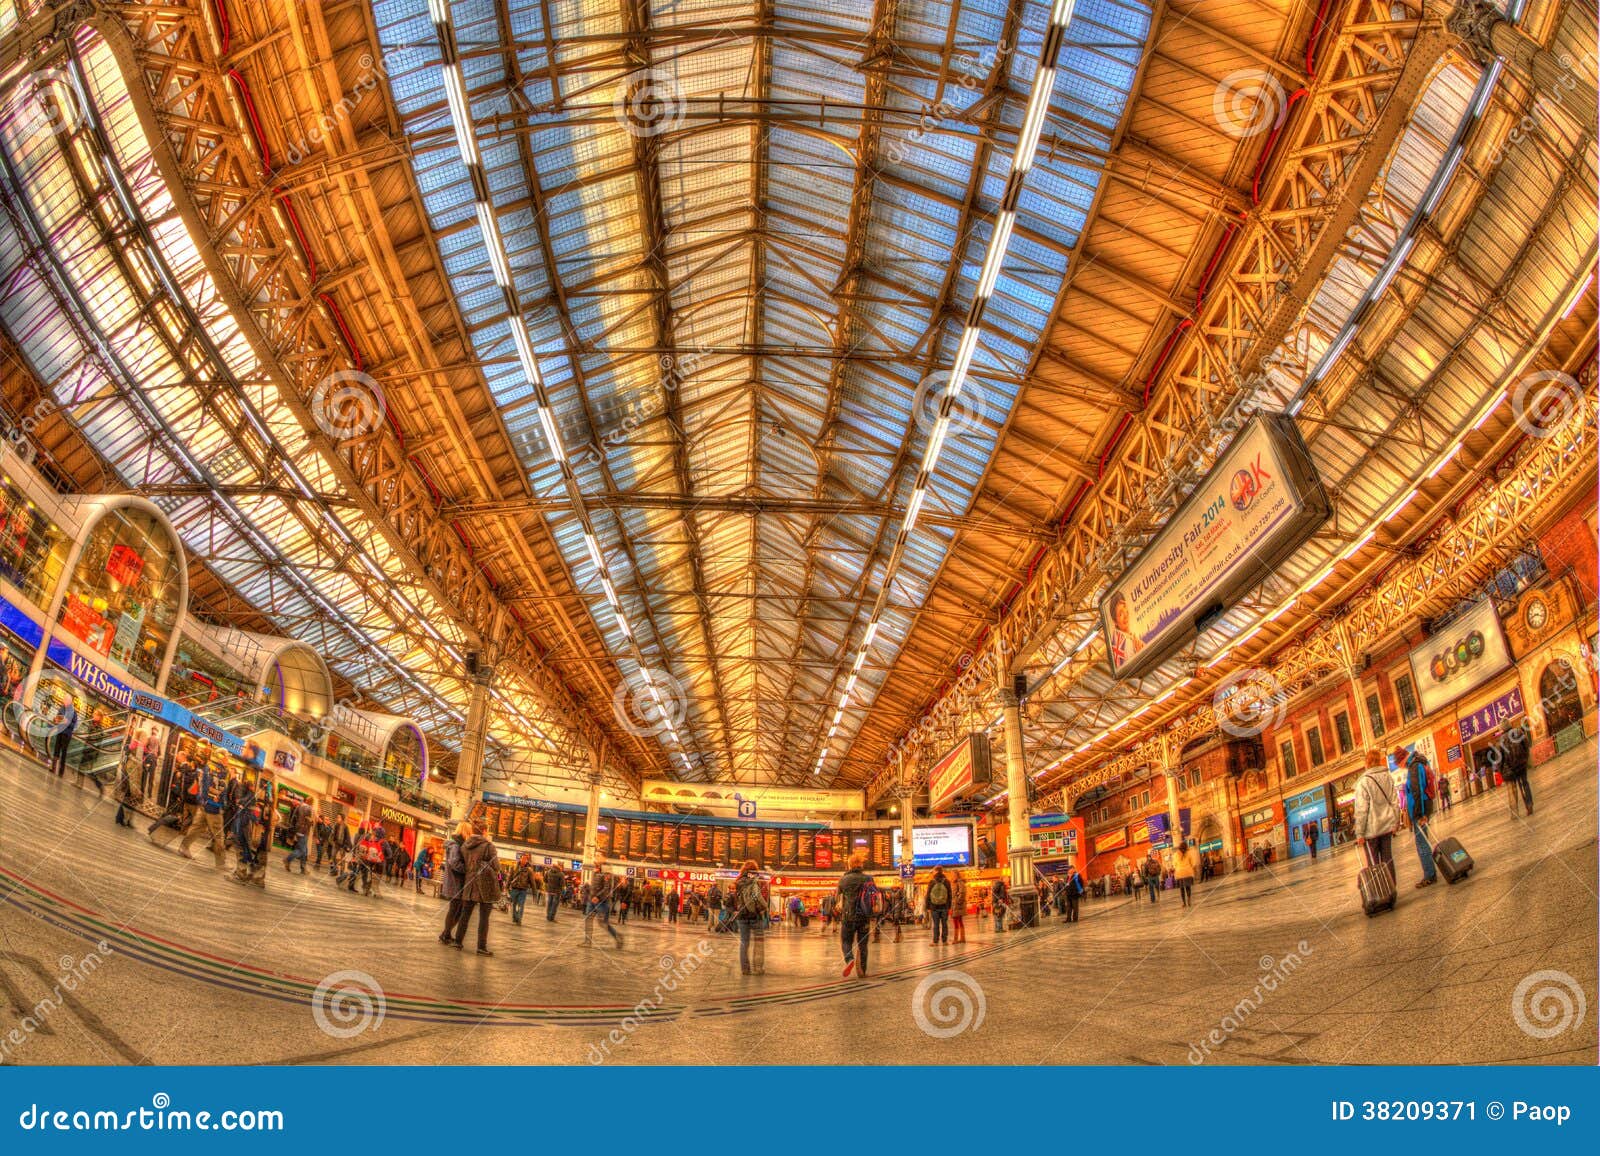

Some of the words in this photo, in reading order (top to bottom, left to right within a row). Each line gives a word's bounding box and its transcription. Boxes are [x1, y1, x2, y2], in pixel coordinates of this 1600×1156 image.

[1130, 586, 1143, 602] UK
[1142, 541, 1184, 591] University
[1183, 523, 1202, 548] Fair
[1201, 494, 1226, 528] 2014
[382, 806, 414, 827] MONSOON
[690, 872, 716, 882] BURG
